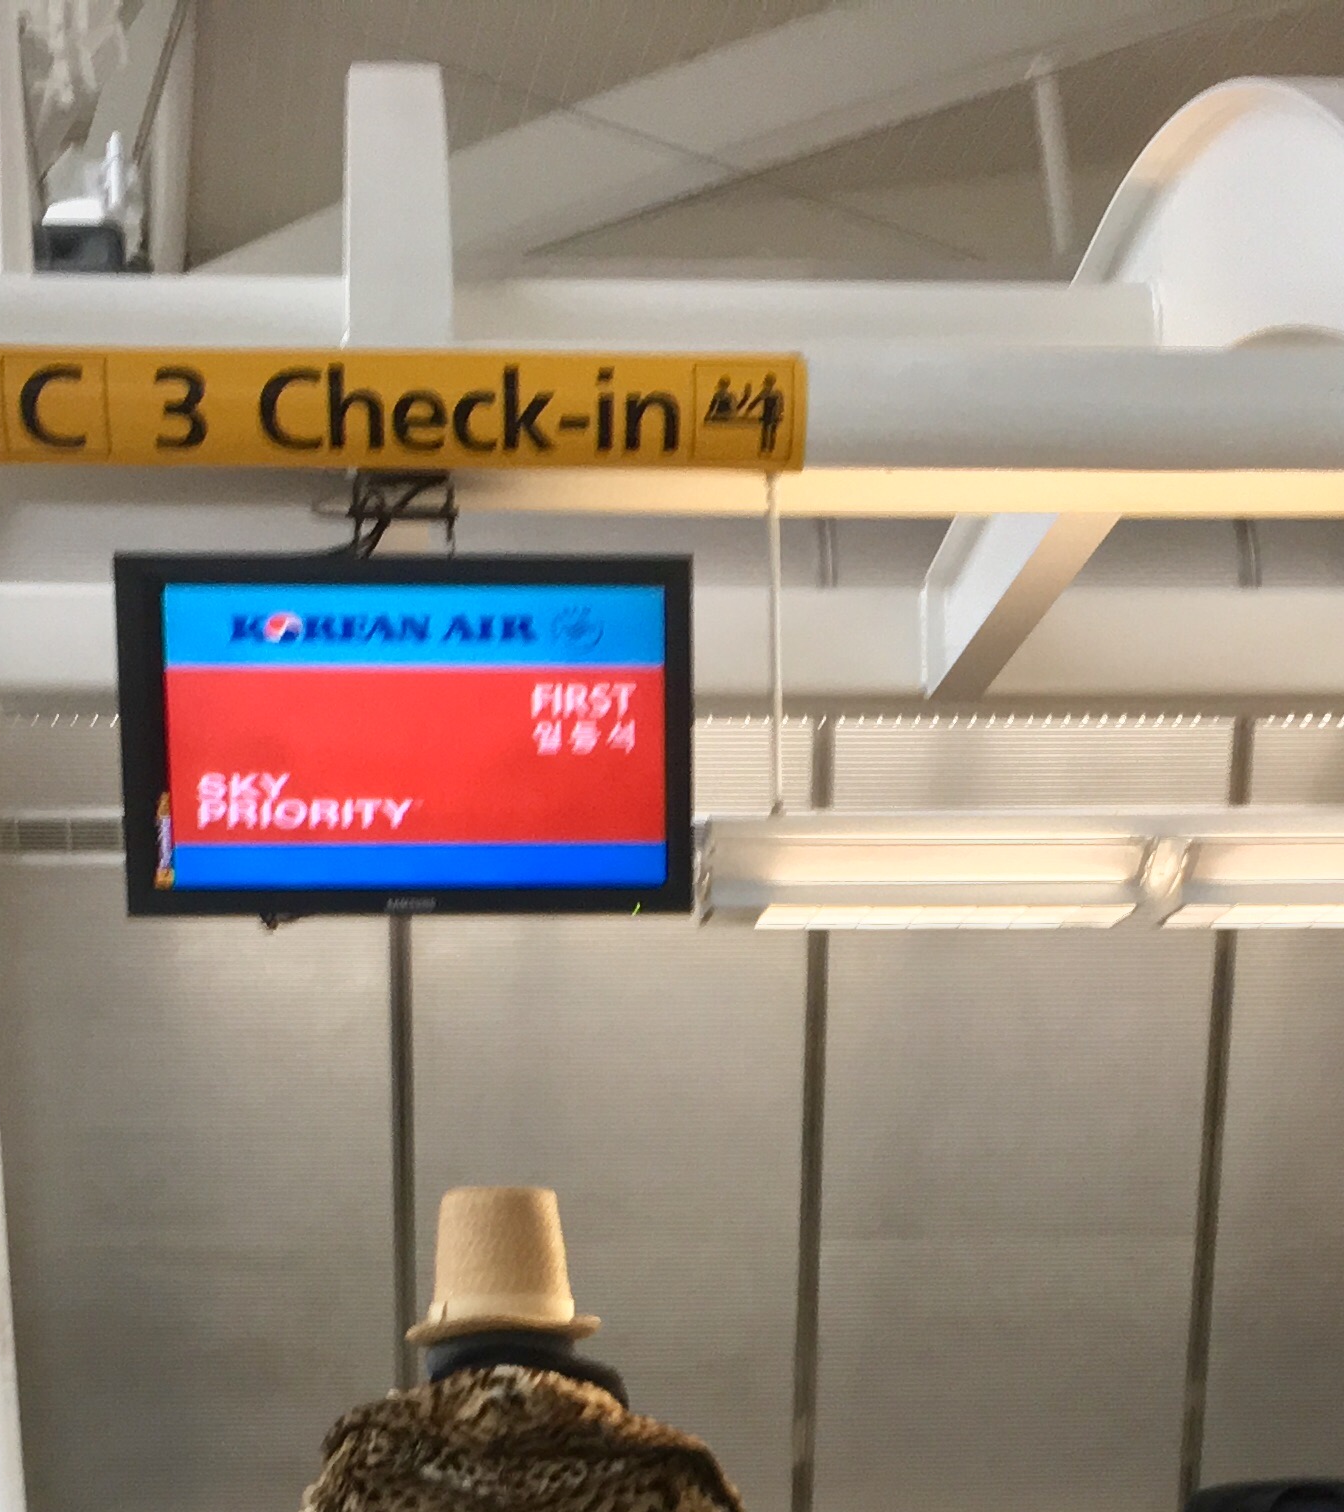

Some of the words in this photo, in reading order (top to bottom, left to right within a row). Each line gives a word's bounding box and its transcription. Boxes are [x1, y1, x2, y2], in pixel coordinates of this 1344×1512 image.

[19, 363, 87, 451] C
[154, 364, 209, 451] 3
[258, 361, 682, 454] Check-in
[229, 610, 432, 648] KOREAN
[441, 614, 540, 645] AIR
[530, 682, 638, 720] FIRST
[196, 772, 292, 801] SKY
[196, 797, 414, 831] PRIORITY
